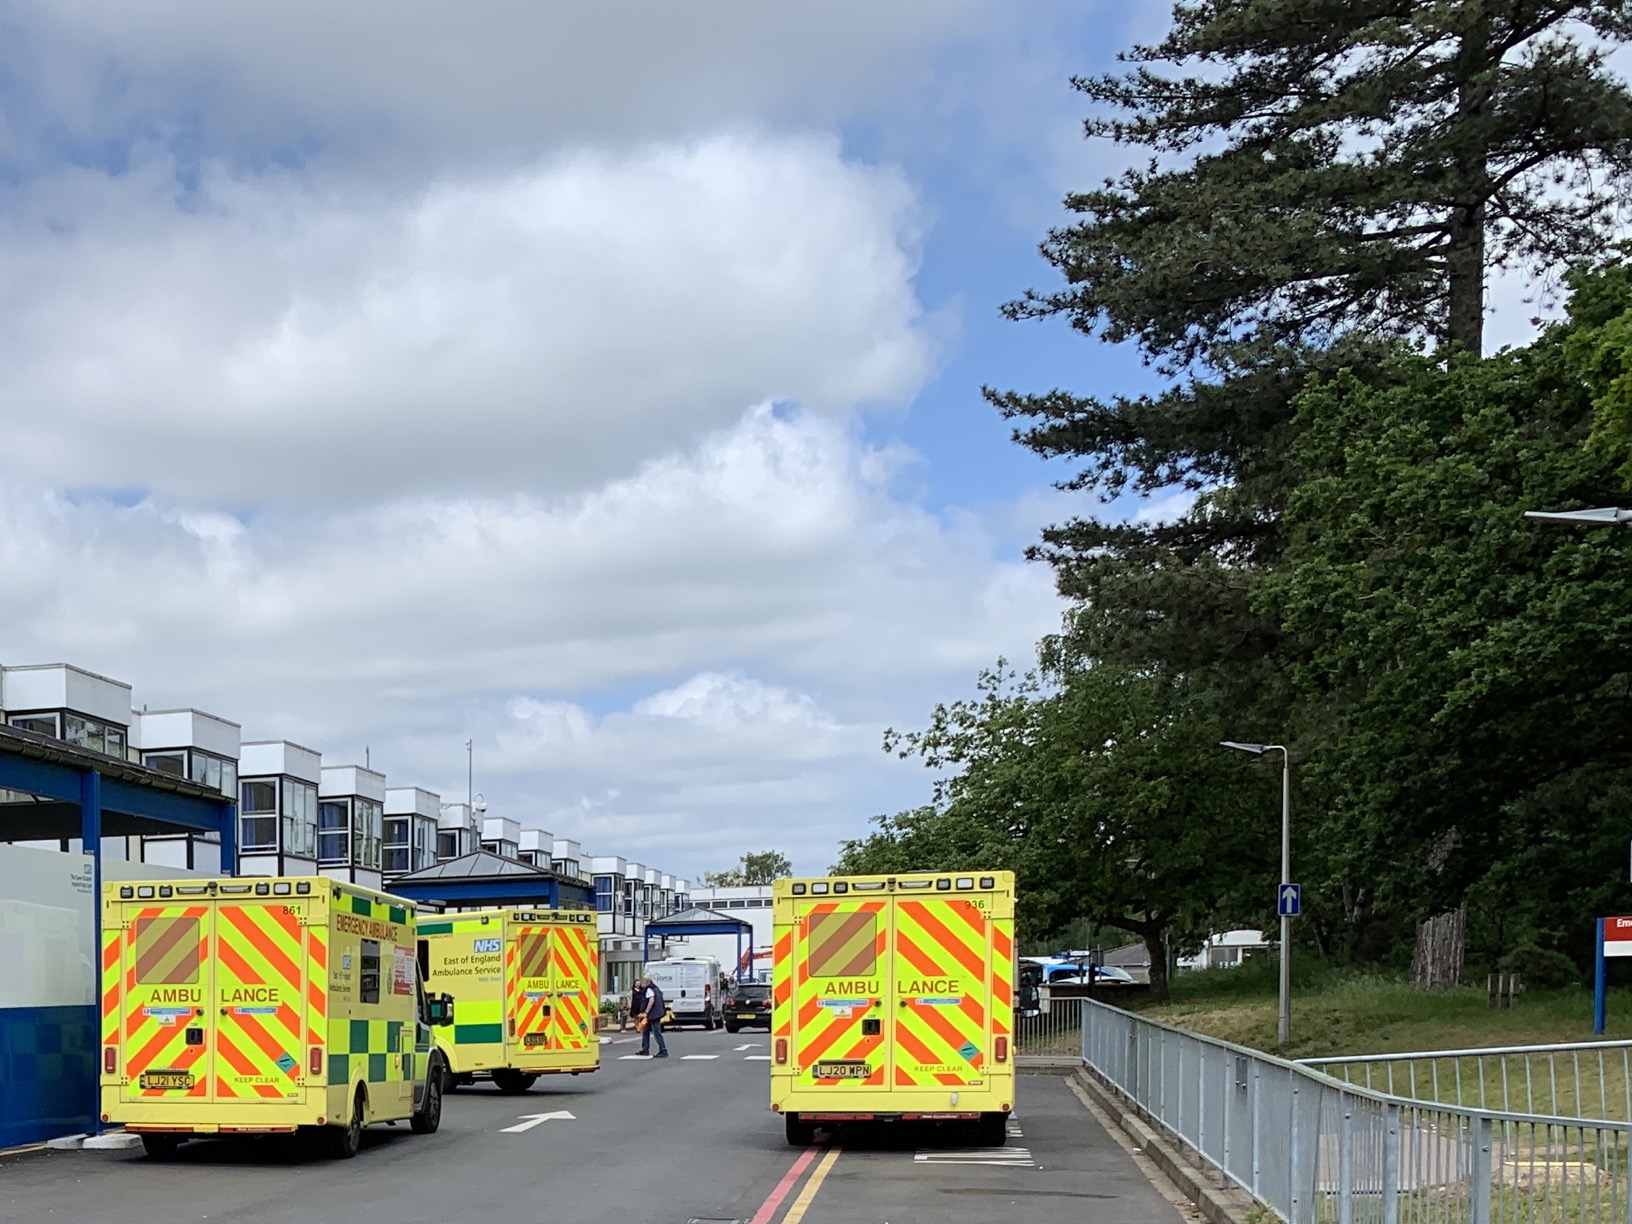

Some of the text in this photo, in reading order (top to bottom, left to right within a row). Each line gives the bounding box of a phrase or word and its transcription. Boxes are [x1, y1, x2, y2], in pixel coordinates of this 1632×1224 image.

[282, 905, 301, 915] 861
[964, 900, 985, 909] 936
[336, 913, 398, 942] EMERGENCY AMBULANCE
[475, 939, 500, 952] NHS
[443, 954, 501, 965] East of England
[432, 966, 501, 977] Ambulance Service
[527, 980, 580, 989] AMBU LANCE
[824, 980, 959, 995] AMBU LANCE
[150, 988, 279, 1003] AMBU LANCE
[819, 1065, 846, 1075] LJ20
[172, 1075, 191, 1086] YSC
